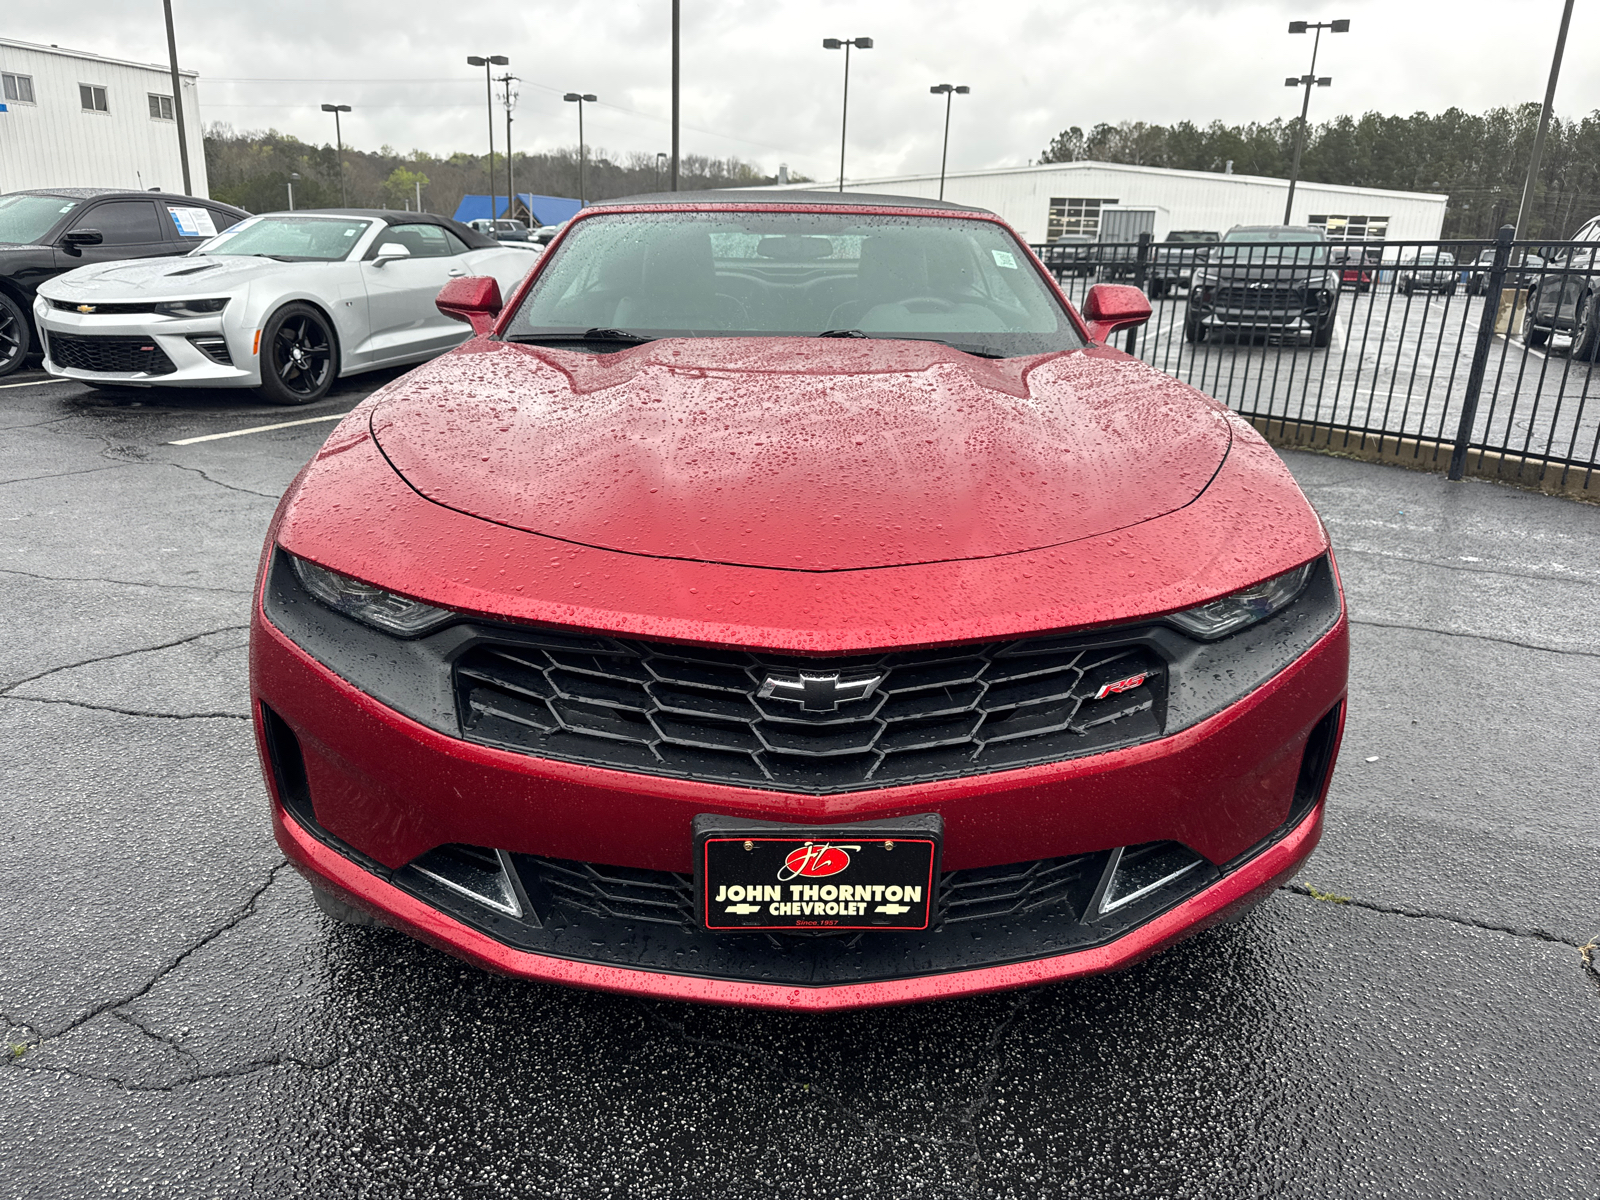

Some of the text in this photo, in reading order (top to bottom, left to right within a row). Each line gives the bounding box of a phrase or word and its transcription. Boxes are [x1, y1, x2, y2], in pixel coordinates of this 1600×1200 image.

[1094, 672, 1148, 699] RS
[715, 885, 922, 903] JOHN THORNTON
[769, 902, 867, 916] CHEVROLET
